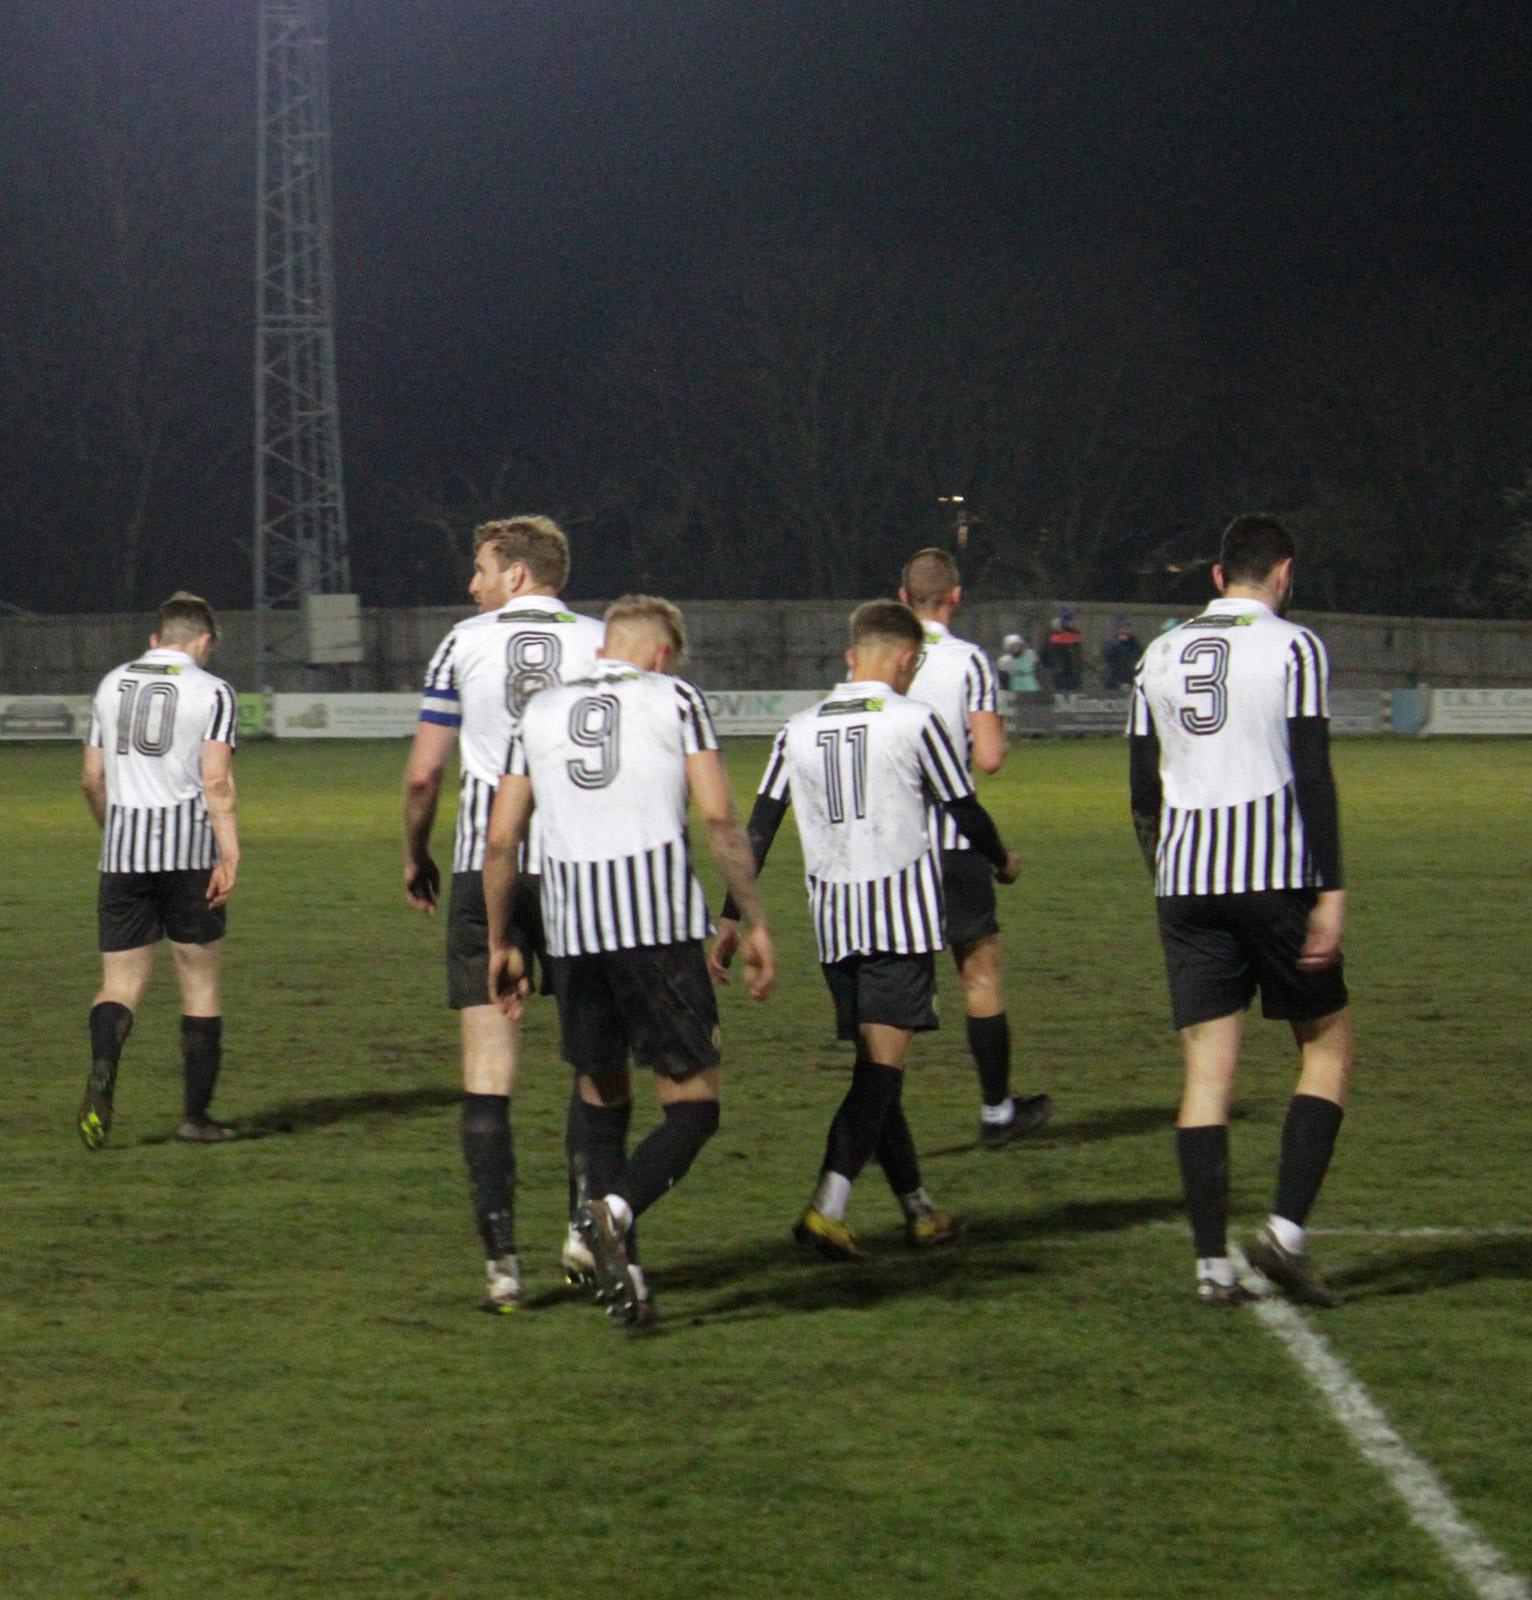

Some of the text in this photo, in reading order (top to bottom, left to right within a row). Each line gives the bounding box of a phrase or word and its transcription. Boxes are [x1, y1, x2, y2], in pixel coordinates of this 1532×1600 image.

[117, 679, 179, 757] 10
[506, 631, 562, 719] 8
[1180, 637, 1230, 736] 3
[567, 694, 621, 790] 9
[816, 725, 868, 824] 11
